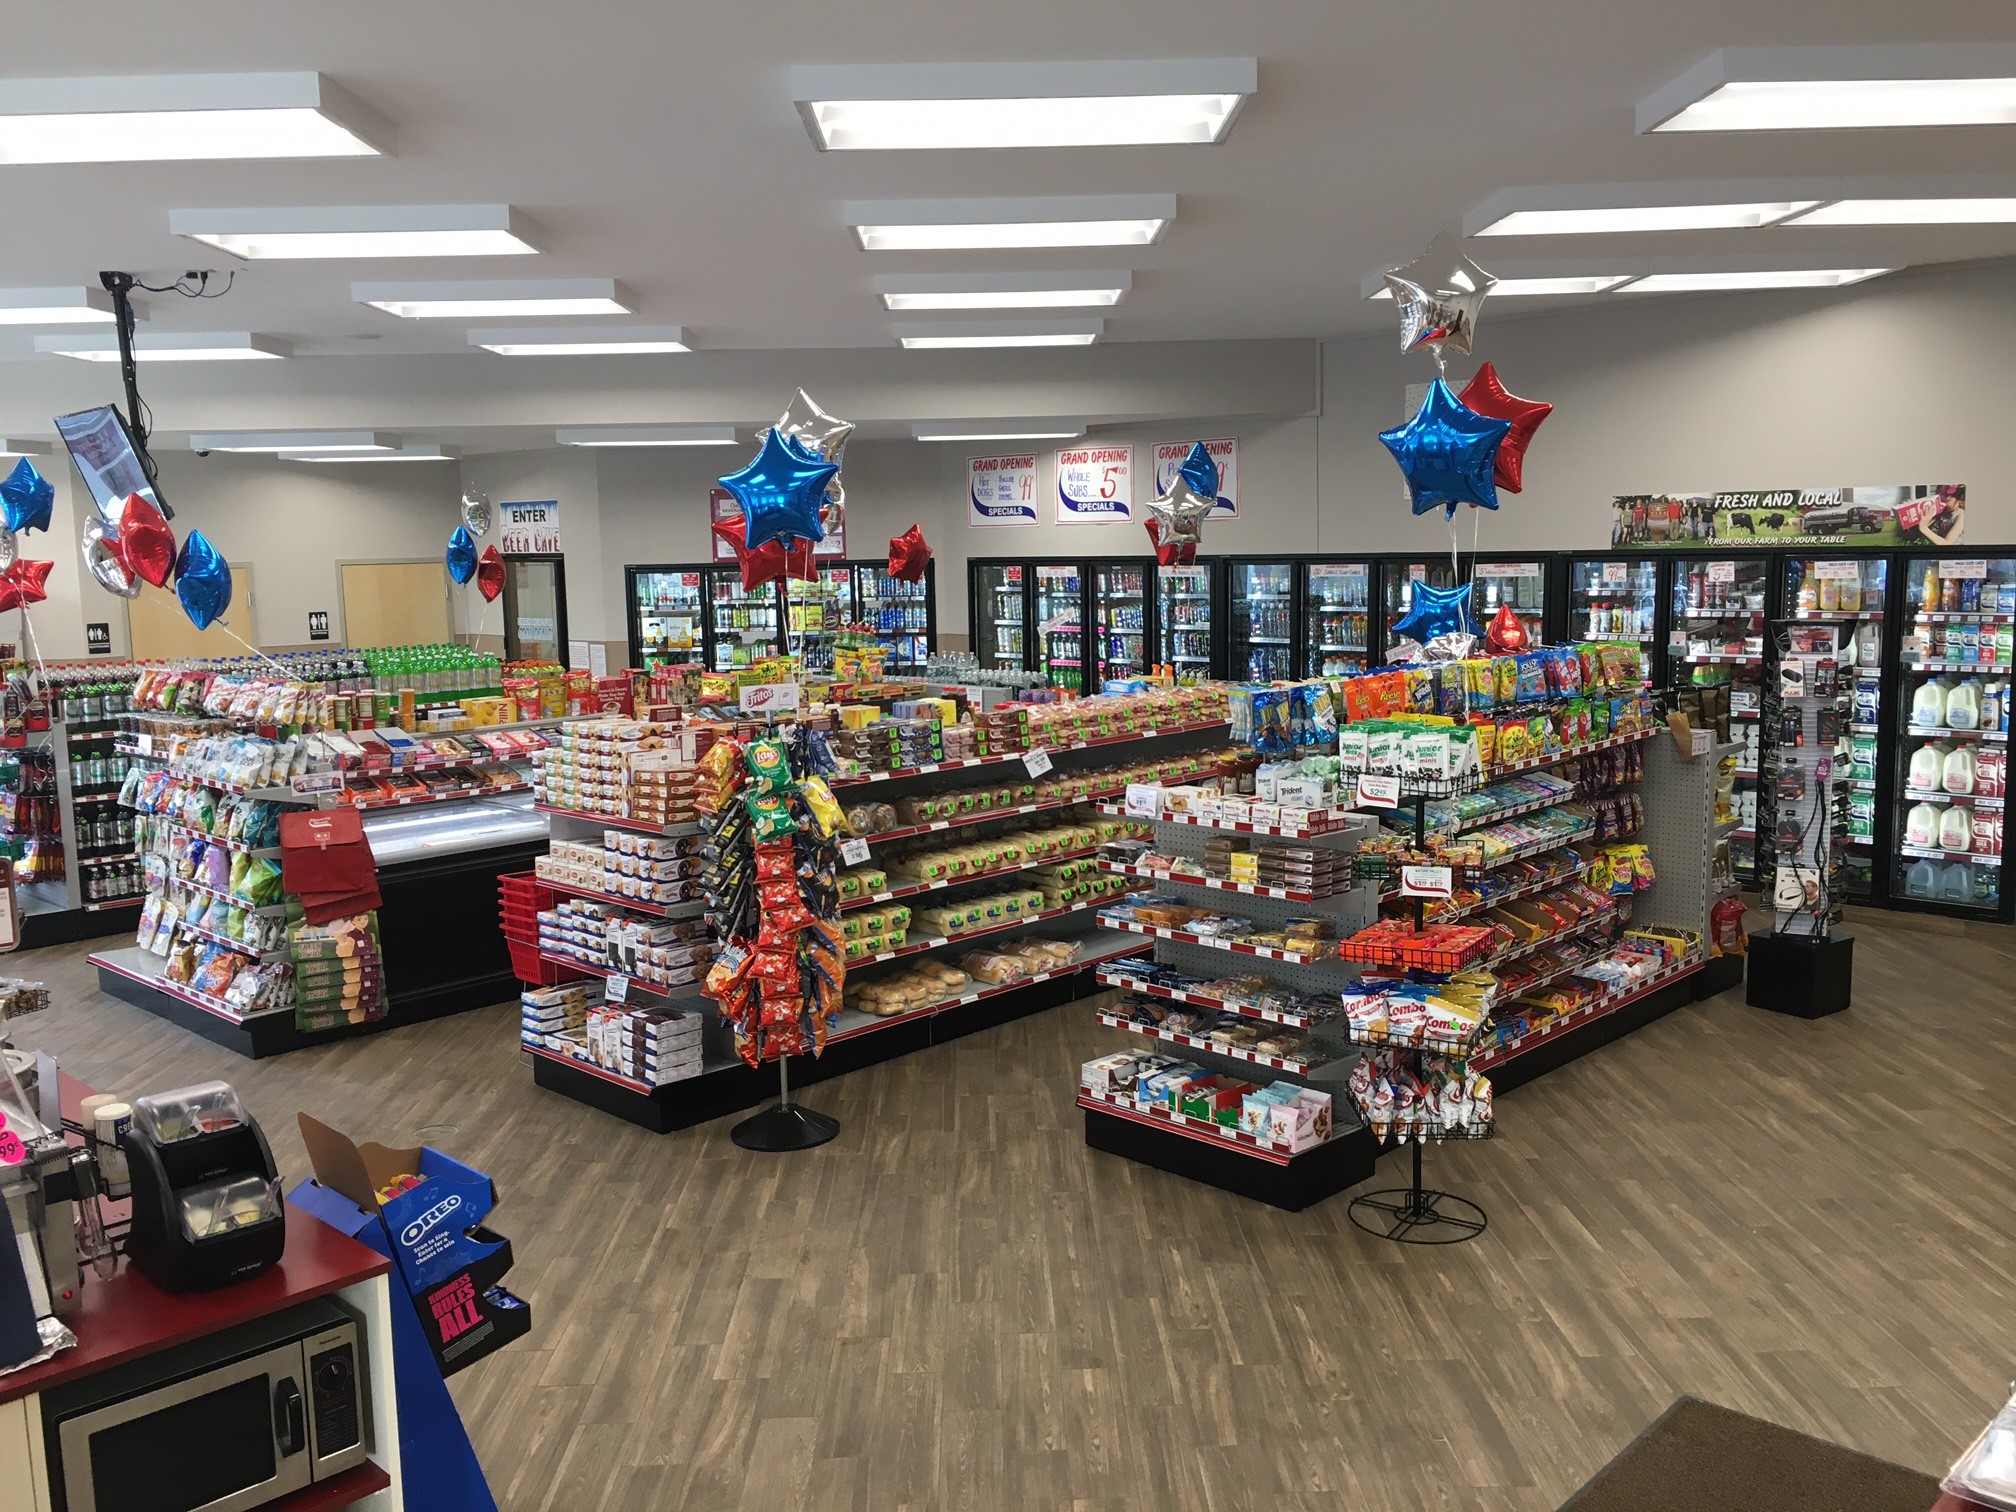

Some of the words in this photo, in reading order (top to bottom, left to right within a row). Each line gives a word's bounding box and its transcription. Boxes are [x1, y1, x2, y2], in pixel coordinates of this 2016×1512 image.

[1061, 452, 1089, 465] GRAND
[1091, 450, 1128, 463] OPENING
[1158, 445, 1190, 459] GRAND
[1205, 442, 1233, 455] ENING
[973, 459, 998, 472] GRAND
[1000, 457, 1034, 470] OPENING
[978, 488, 993, 497] DOGS
[1714, 494, 1759, 509] FRESH
[1762, 493, 1793, 507] AND
[1797, 491, 1842, 506] LOCAL
[988, 506, 1023, 516] SPECIALS
[1077, 502, 1115, 511] SPECIALS
[512, 509, 546, 523] ENTER
[501, 524, 530, 552] BEER
[534, 524, 560, 552] CAVE
[1709, 538, 1732, 546] FROM
[1734, 537, 1753, 545] OUR
[1754, 536, 1778, 545] FARM
[1781, 536, 1791, 544] TO
[1793, 535, 1817, 544] YOUR
[1820, 535, 1846, 544] TABLE
[1520, 660, 1537, 671] JOLLY
[746, 688, 774, 708] Fritos
[1416, 744, 1442, 753] Junior
[1281, 786, 1303, 796] Trident
[1344, 991, 1387, 1014] Combos
[1388, 1003, 1426, 1017] Combo
[401, 1196, 461, 1246] OREO
[413, 1241, 429, 1254] Scan
[429, 1238, 435, 1247] to
[435, 1230, 450, 1242] Sing.
[417, 1245, 433, 1257] Enter
[434, 1241, 442, 1250] for
[415, 1252, 436, 1265] Chance
[444, 1239, 455, 1249] win
[428, 1273, 472, 1305] KINDNESS
[431, 1283, 475, 1320] RULES
[438, 1298, 484, 1344] ALL
